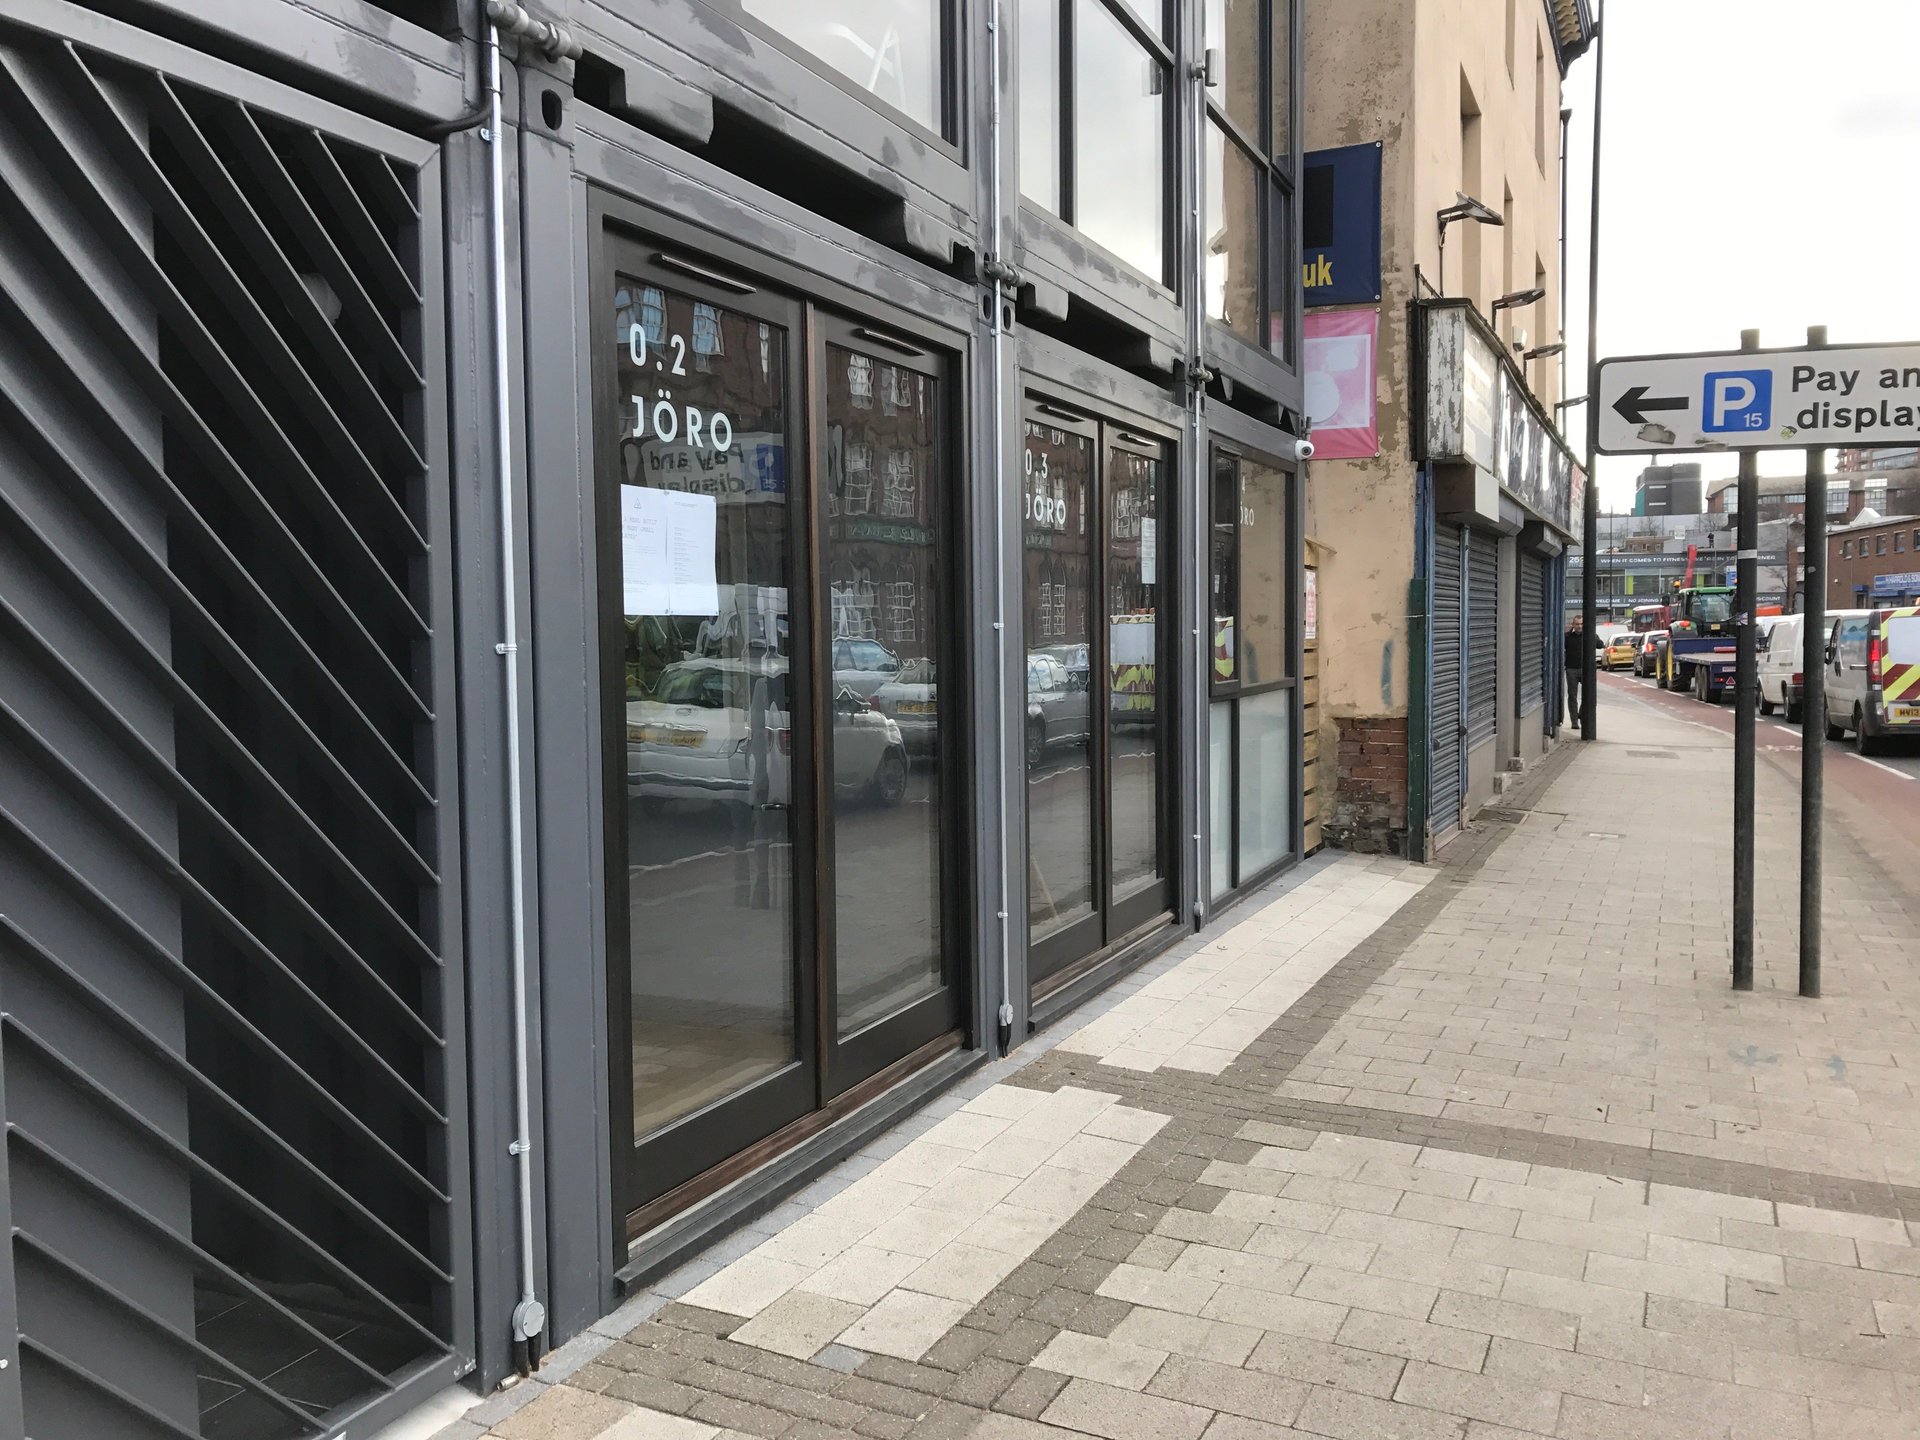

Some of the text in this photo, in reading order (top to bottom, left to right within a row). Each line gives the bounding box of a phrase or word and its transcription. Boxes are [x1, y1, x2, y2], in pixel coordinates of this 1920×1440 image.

[1303, 254, 1333, 288] uk
[629, 323, 686, 377] 0.2
[1792, 365, 1860, 396] Pay
[1713, 377, 1756, 427] P
[1797, 400, 1920, 433] displa
[631, 388, 733, 452] JÖRO
[1744, 412, 1762, 428] 15
[1025, 448, 1048, 479] 0.3
[1025, 488, 1066, 525] JÖRO
